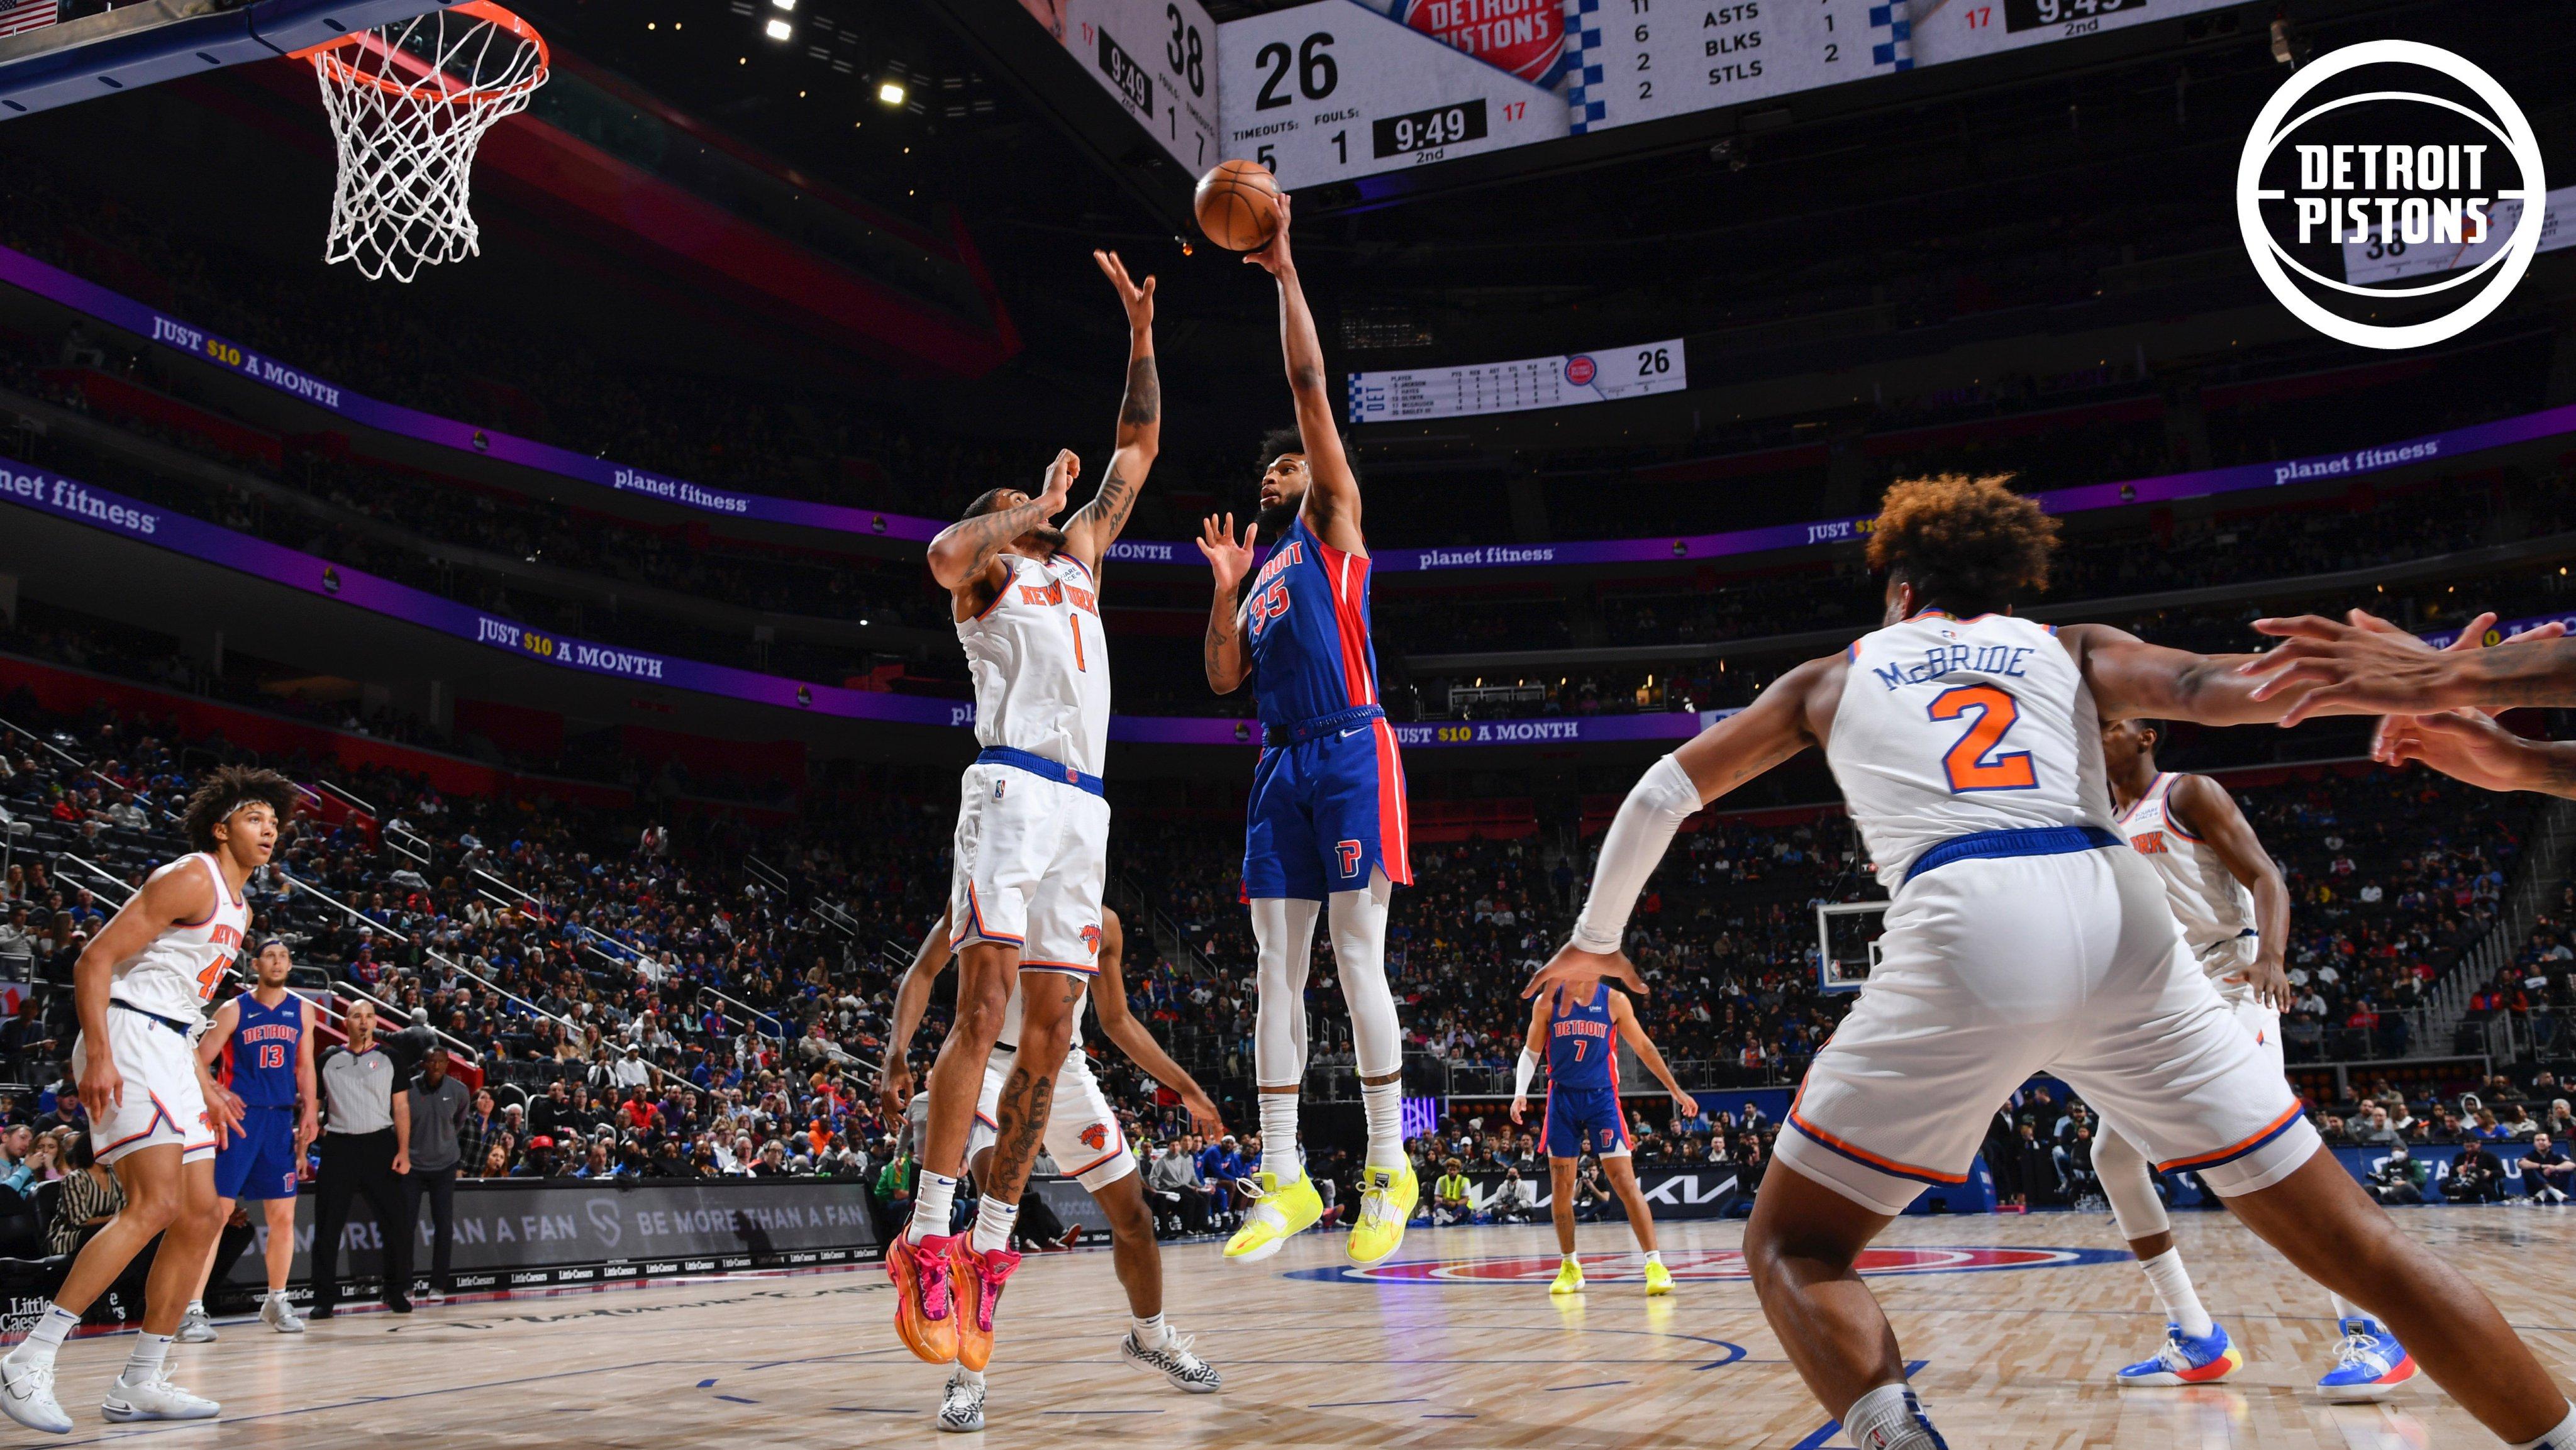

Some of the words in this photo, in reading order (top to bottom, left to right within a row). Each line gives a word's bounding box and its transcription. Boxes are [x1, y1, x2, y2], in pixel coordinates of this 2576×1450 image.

[1703, 3, 1759, 28] ASTS
[1824, 14, 1833, 32] 1
[1965, 6, 1992, 30] 17
[2065, 18, 2099, 36] 2nd
[1082, 22, 1094, 46] 17
[1635, 25, 1648, 43] 6
[1706, 31, 1762, 57] BLKS
[1167, 3, 1204, 97] 38
[1636, 53, 1651, 71] 2
[1824, 44, 1839, 63] 2
[1111, 47, 1145, 106] 9:49
[1255, 31, 1338, 112] 26
[1709, 60, 1762, 86] STLS
[1639, 82, 1653, 100] 2
[1169, 106, 1175, 141] 1
[1314, 109, 1360, 126] FOULS:
[1503, 102, 1526, 122] 17
[1233, 121, 1299, 141] TIMEOUTS:
[1394, 108, 1465, 151] 9:49
[1196, 131, 1204, 166] 7
[1331, 130, 1347, 164] 1
[1416, 148, 1444, 164] 2nd
[152, 316, 201, 352] JUST
[206, 338, 241, 367] $10
[245, 355, 259, 375] A
[263, 361, 340, 408] MONTH
[1638, 348, 1670, 376] 26
[1366, 387, 1384, 411] DET
[2274, 453, 2352, 486] planet
[2357, 438, 2438, 470] fitness
[0, 467, 44, 502] net
[52, 480, 156, 535] fitness
[613, 468, 675, 498] planet
[679, 484, 747, 513] fitness
[1807, 522, 1850, 544] JUST
[1855, 519, 1874, 534] $1
[1419, 549, 1480, 570] planet
[1485, 546, 1553, 563] fitness
[1018, 578, 1063, 607] NEW
[1063, 583, 1099, 619] ORK
[1250, 575, 1291, 635] 35
[477, 617, 519, 647] JUST
[523, 633, 553, 656] $10
[557, 641, 573, 662] A
[577, 645, 663, 679] MONTH
[1070, 612, 1085, 673] 1
[1872, 644, 2036, 691] McBRIDE
[1396, 727, 1433, 744] UST
[1438, 726, 1472, 743] $10
[1477, 724, 1492, 741] A
[1496, 721, 1579, 741] MONTH
[1926, 681, 2041, 795] 2
[242, 1024, 299, 1045] DETROIT
[1553, 1019, 1608, 1039] DETROIT
[259, 1044, 285, 1069] 13
[1574, 1039, 1587, 1062] 7
[497, 1216, 516, 1243] A
[521, 1214, 578, 1242] FAN
[636, 1210, 669, 1237] BE
[674, 1209, 741, 1234] MORE
[742, 1205, 803, 1231] THAN
[809, 1205, 823, 1227] A
[824, 1205, 865, 1226] FAN
[9, 1296, 52, 1316] Little
